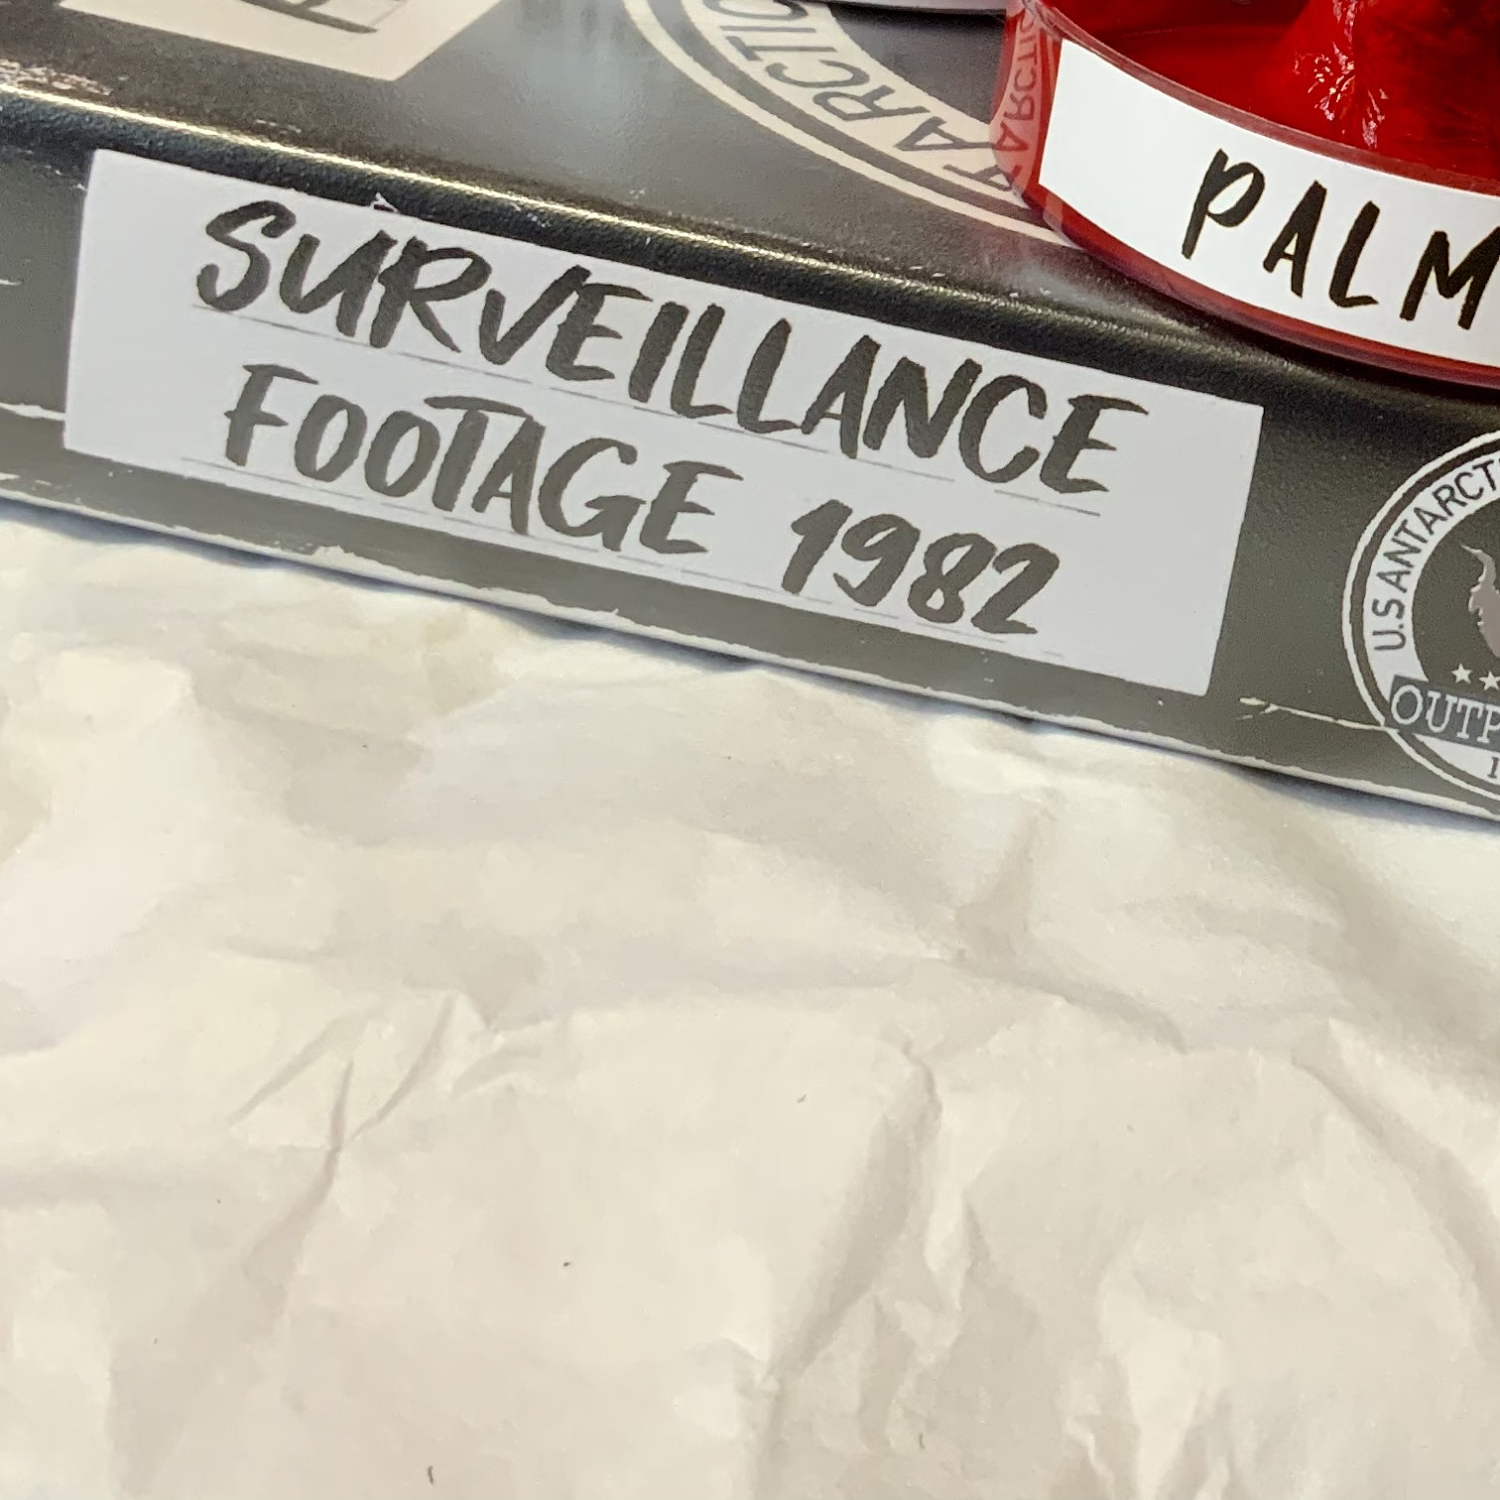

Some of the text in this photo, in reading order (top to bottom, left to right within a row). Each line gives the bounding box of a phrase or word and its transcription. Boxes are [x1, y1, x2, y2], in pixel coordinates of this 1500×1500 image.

[196, 200, 1150, 497] SURVEILLANCE
[224, 364, 1062, 636] FOOTAGE 1982
